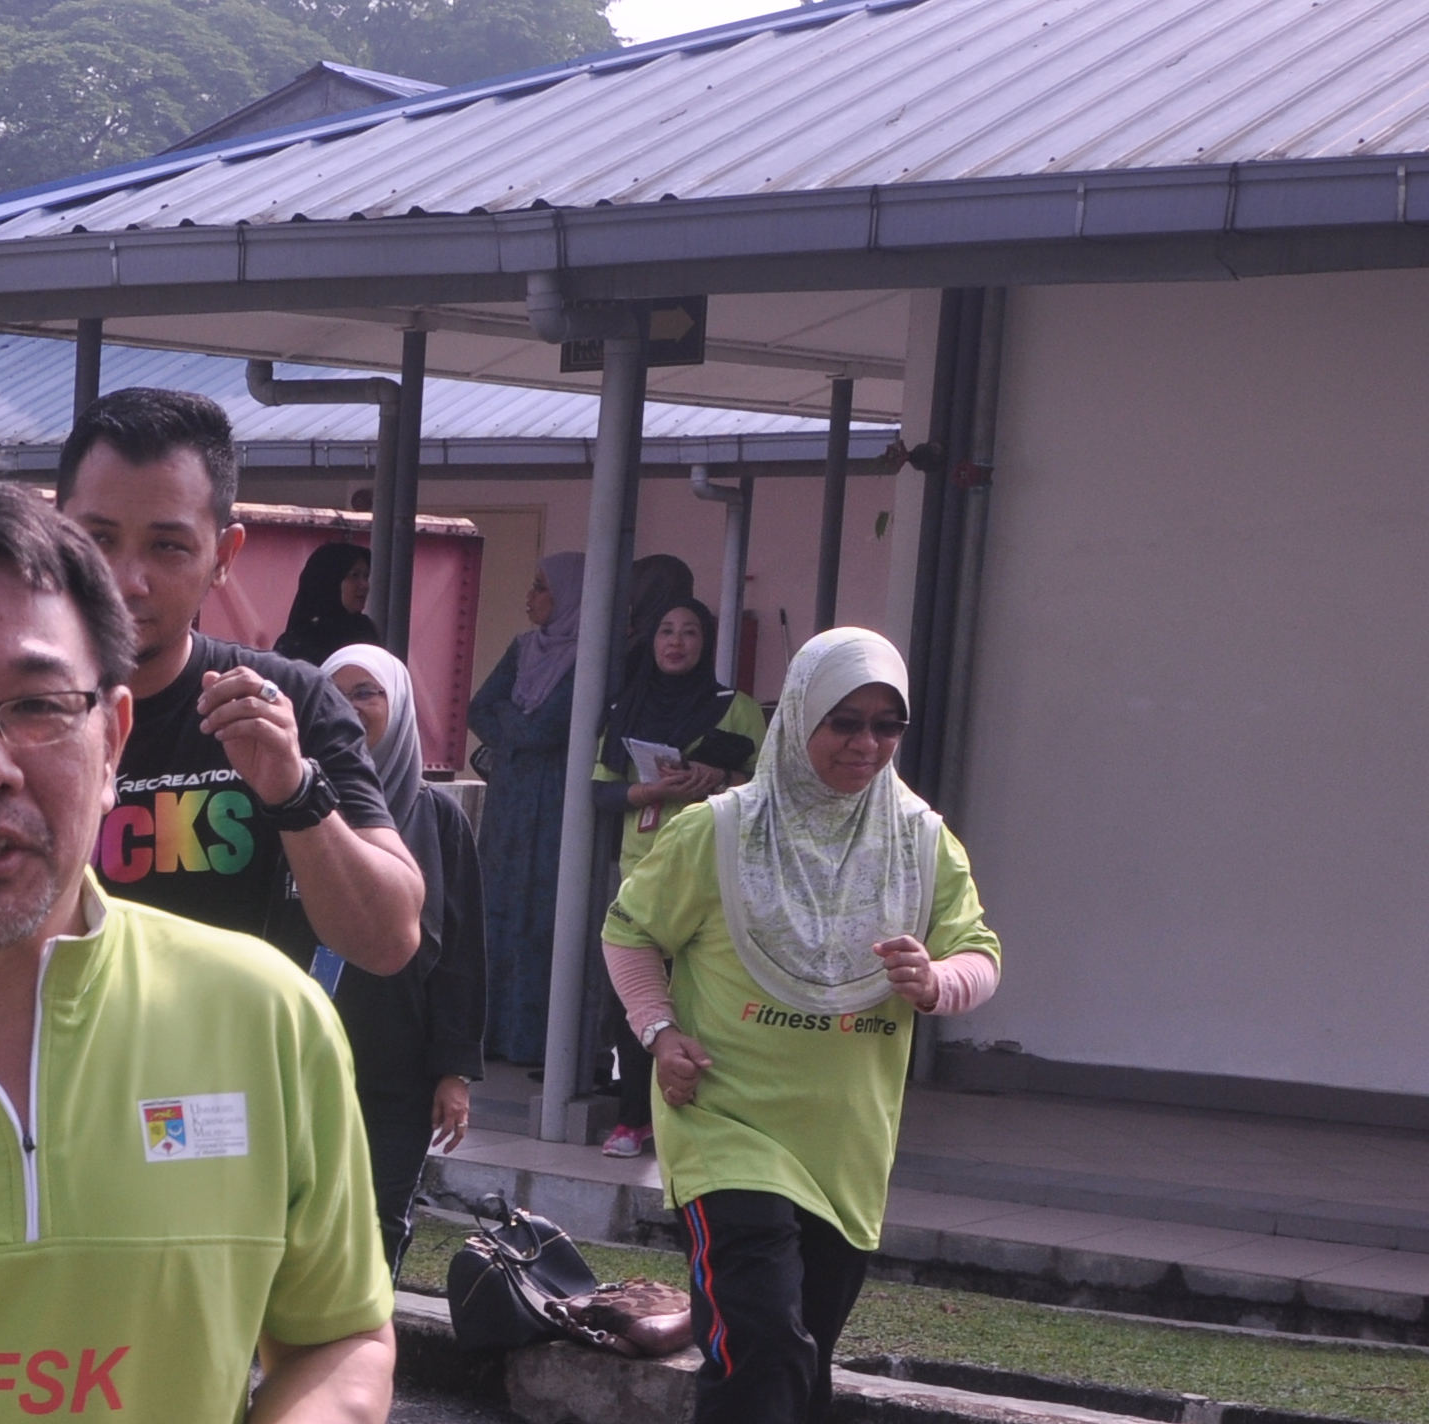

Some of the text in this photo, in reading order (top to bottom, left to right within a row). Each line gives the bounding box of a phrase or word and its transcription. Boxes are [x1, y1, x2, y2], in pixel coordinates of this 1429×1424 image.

[94, 790, 255, 884] CKS
[741, 1002, 897, 1035] Fitness Centre
